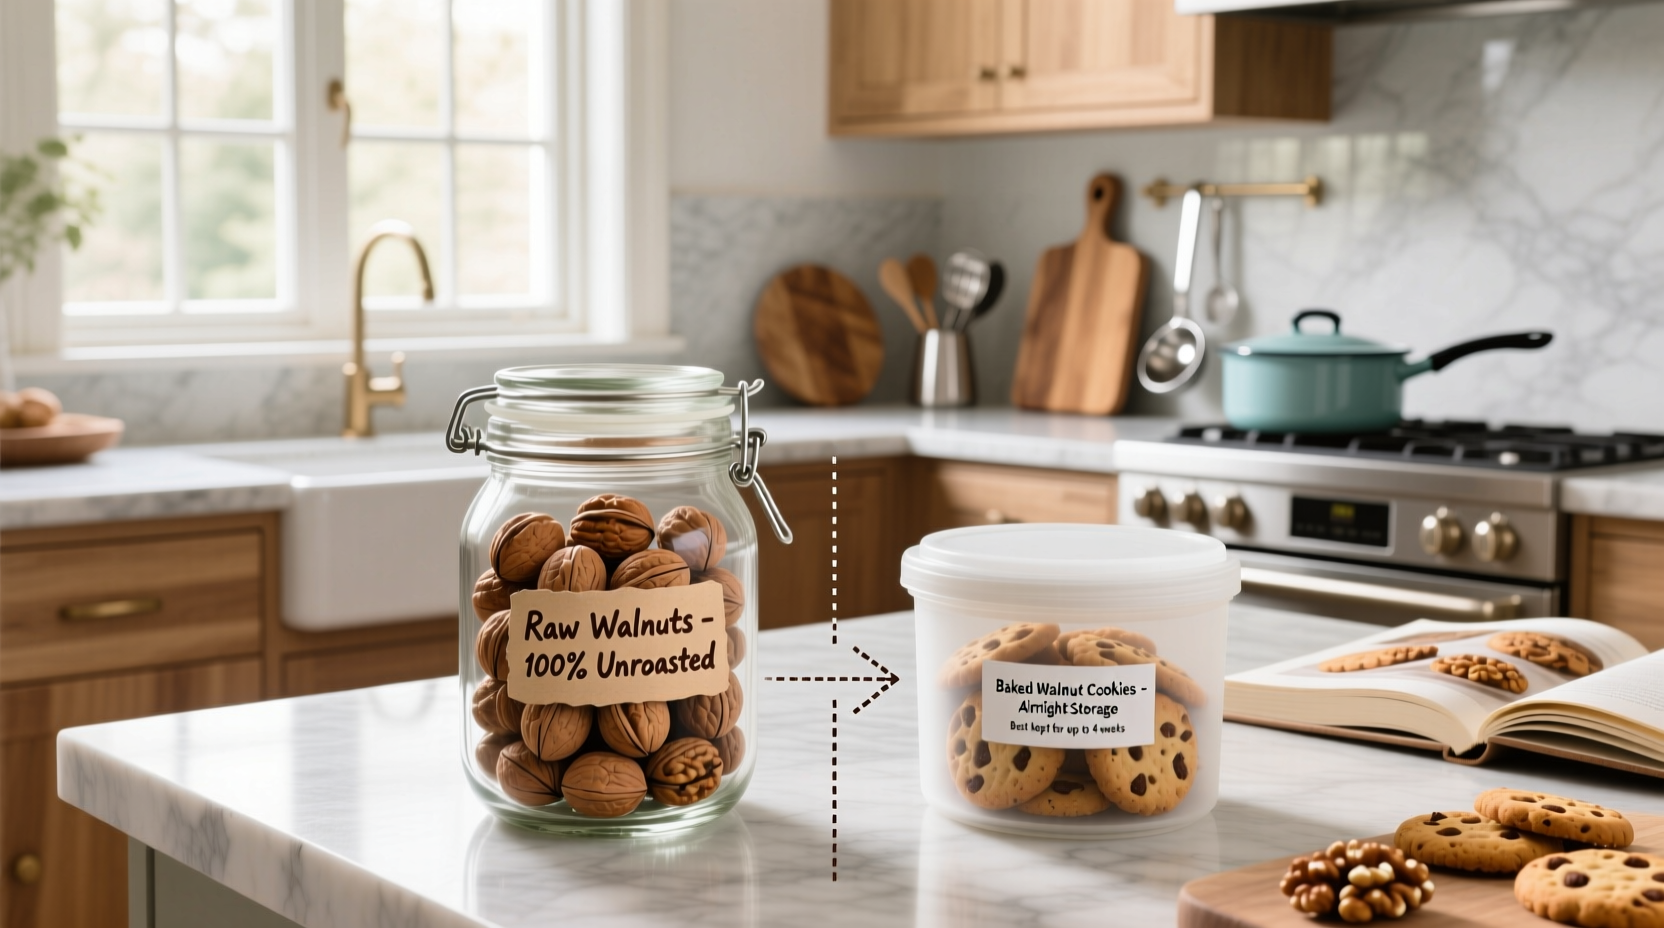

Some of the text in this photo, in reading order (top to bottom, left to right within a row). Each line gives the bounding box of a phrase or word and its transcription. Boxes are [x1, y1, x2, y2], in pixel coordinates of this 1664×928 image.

[524, 609, 580, 642] Raw
[590, 607, 693, 640] Walnuts
[524, 640, 716, 681] 100% Unroasted
[996, 678, 1033, 695] Baked
[1036, 682, 1083, 697] Walnut
[1087, 680, 1136, 696] Cookies
[1070, 702, 1119, 719] Storage
[1066, 725, 1079, 737] up
[1092, 723, 1098, 734] 4
